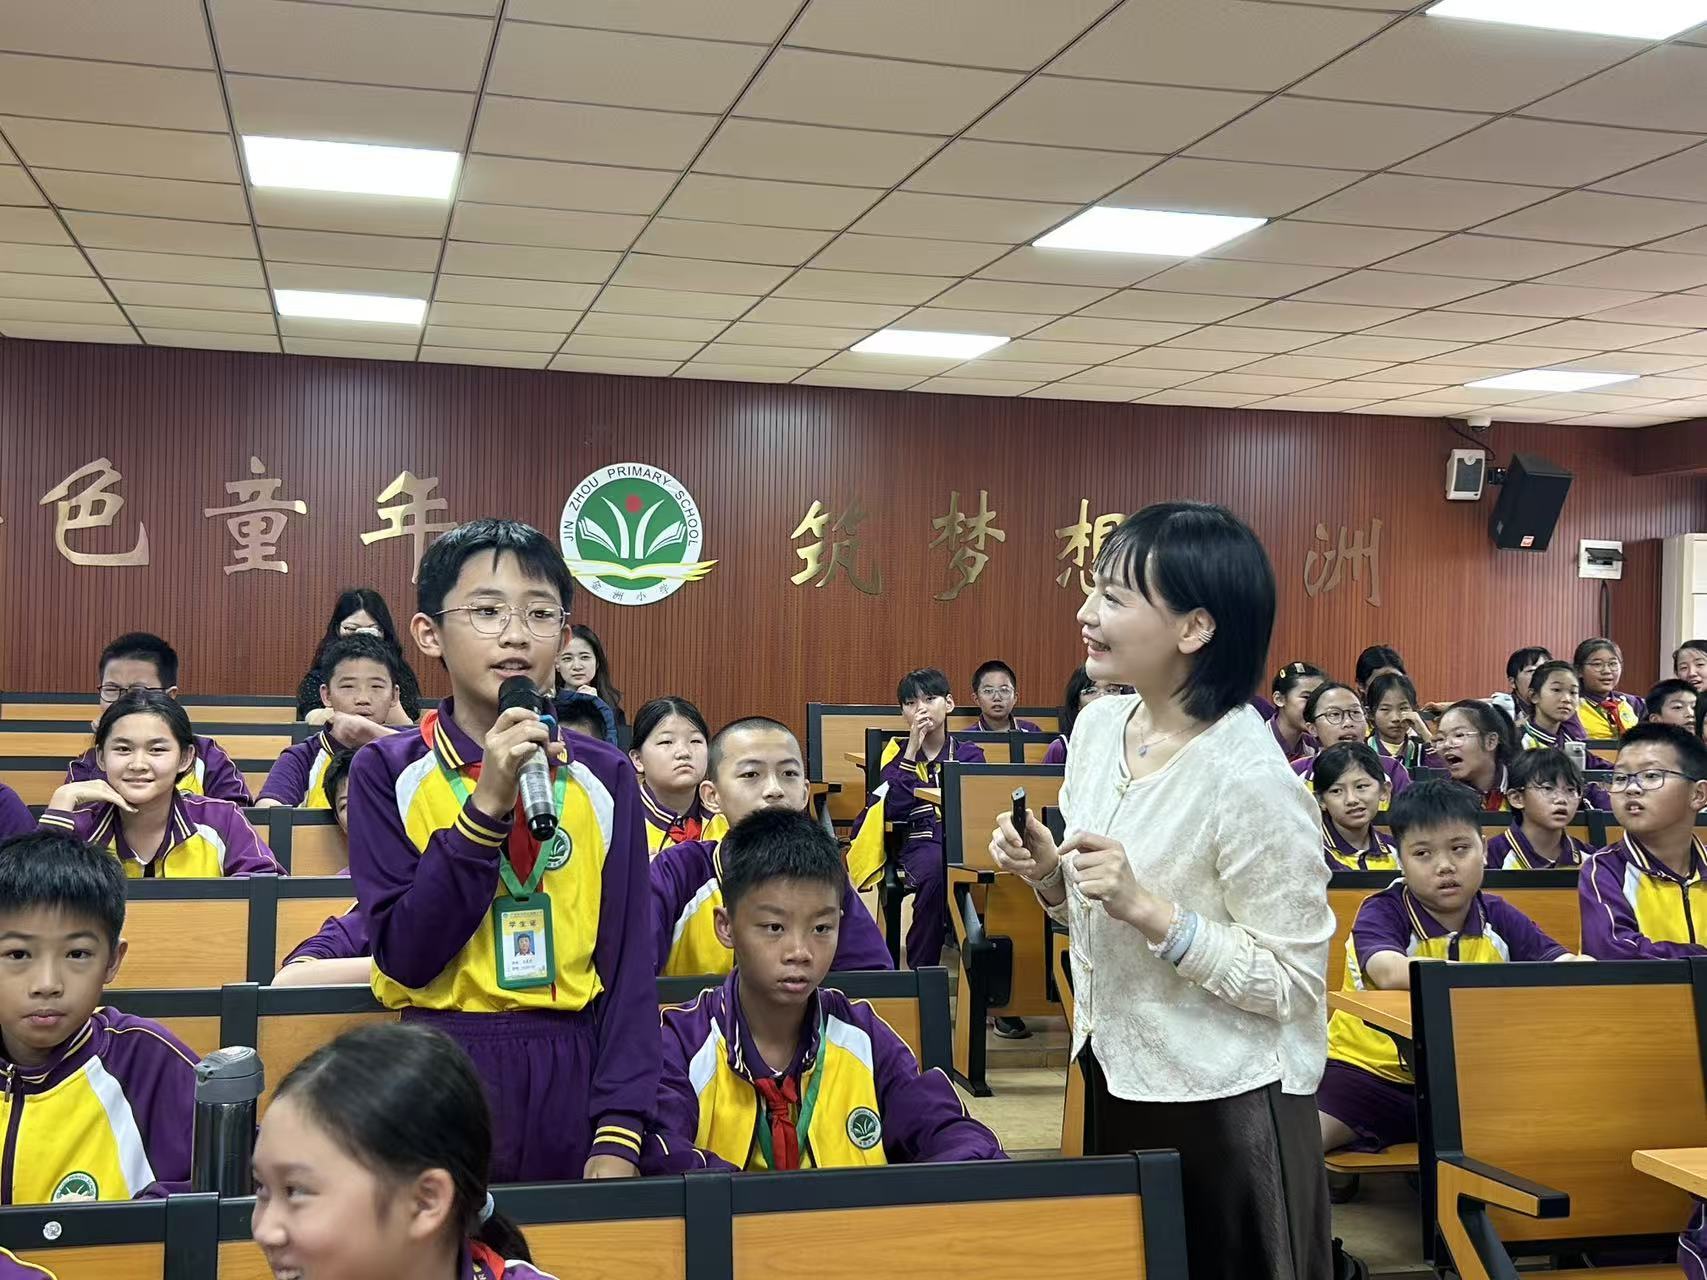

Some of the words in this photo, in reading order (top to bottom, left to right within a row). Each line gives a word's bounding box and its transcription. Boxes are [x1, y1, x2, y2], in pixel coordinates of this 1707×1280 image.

[568, 476, 600, 512] ZHOU
[607, 465, 672, 487] PRIMARY
[0, 456, 458, 584] 色童年
[563, 520, 574, 542] JIN
[674, 490, 699, 547] SCHOOL
